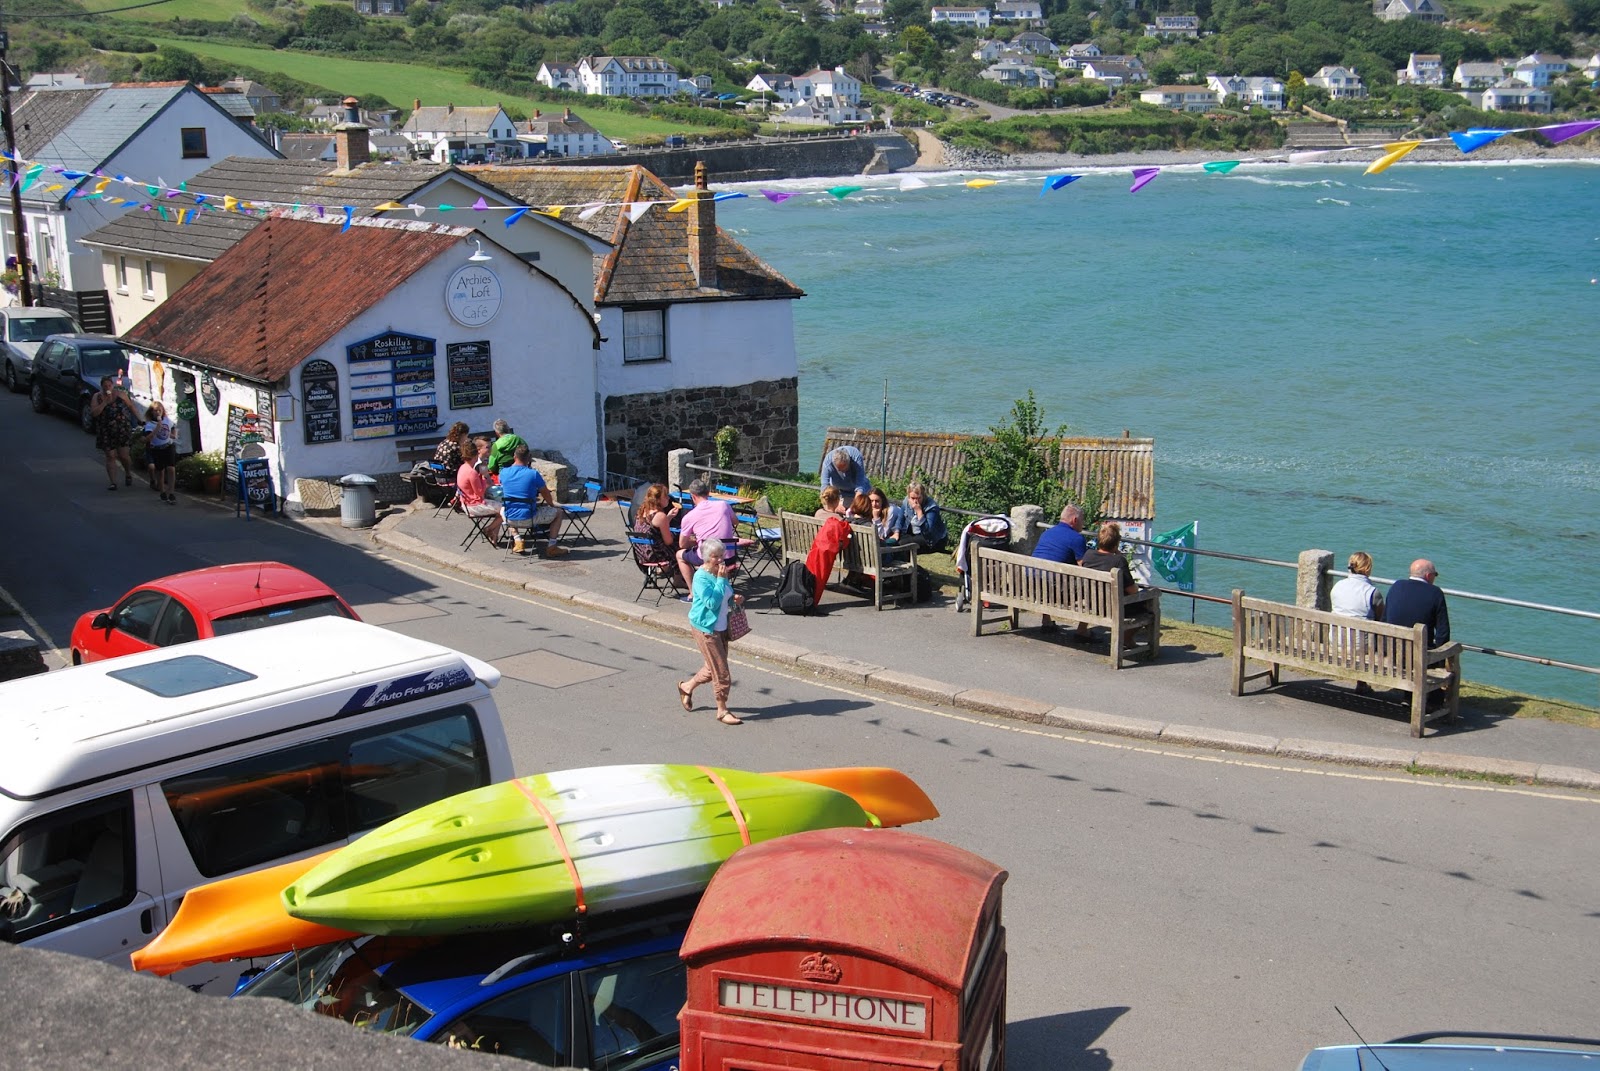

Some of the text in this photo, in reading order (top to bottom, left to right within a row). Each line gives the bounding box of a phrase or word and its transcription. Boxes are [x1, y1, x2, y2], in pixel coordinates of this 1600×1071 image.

[456, 273, 492, 290] Archies
[471, 285, 491, 299] Loft
[462, 304, 488, 320] Café
[374, 337, 411, 348] Roskilly's
[179, 406, 195, 416] Open
[397, 421, 437, 433] ARMADILLO
[248, 487, 270, 500] Pizza
[377, 681, 444, 703] Auto Free Top
[729, 980, 917, 1026] TELEPHONE
